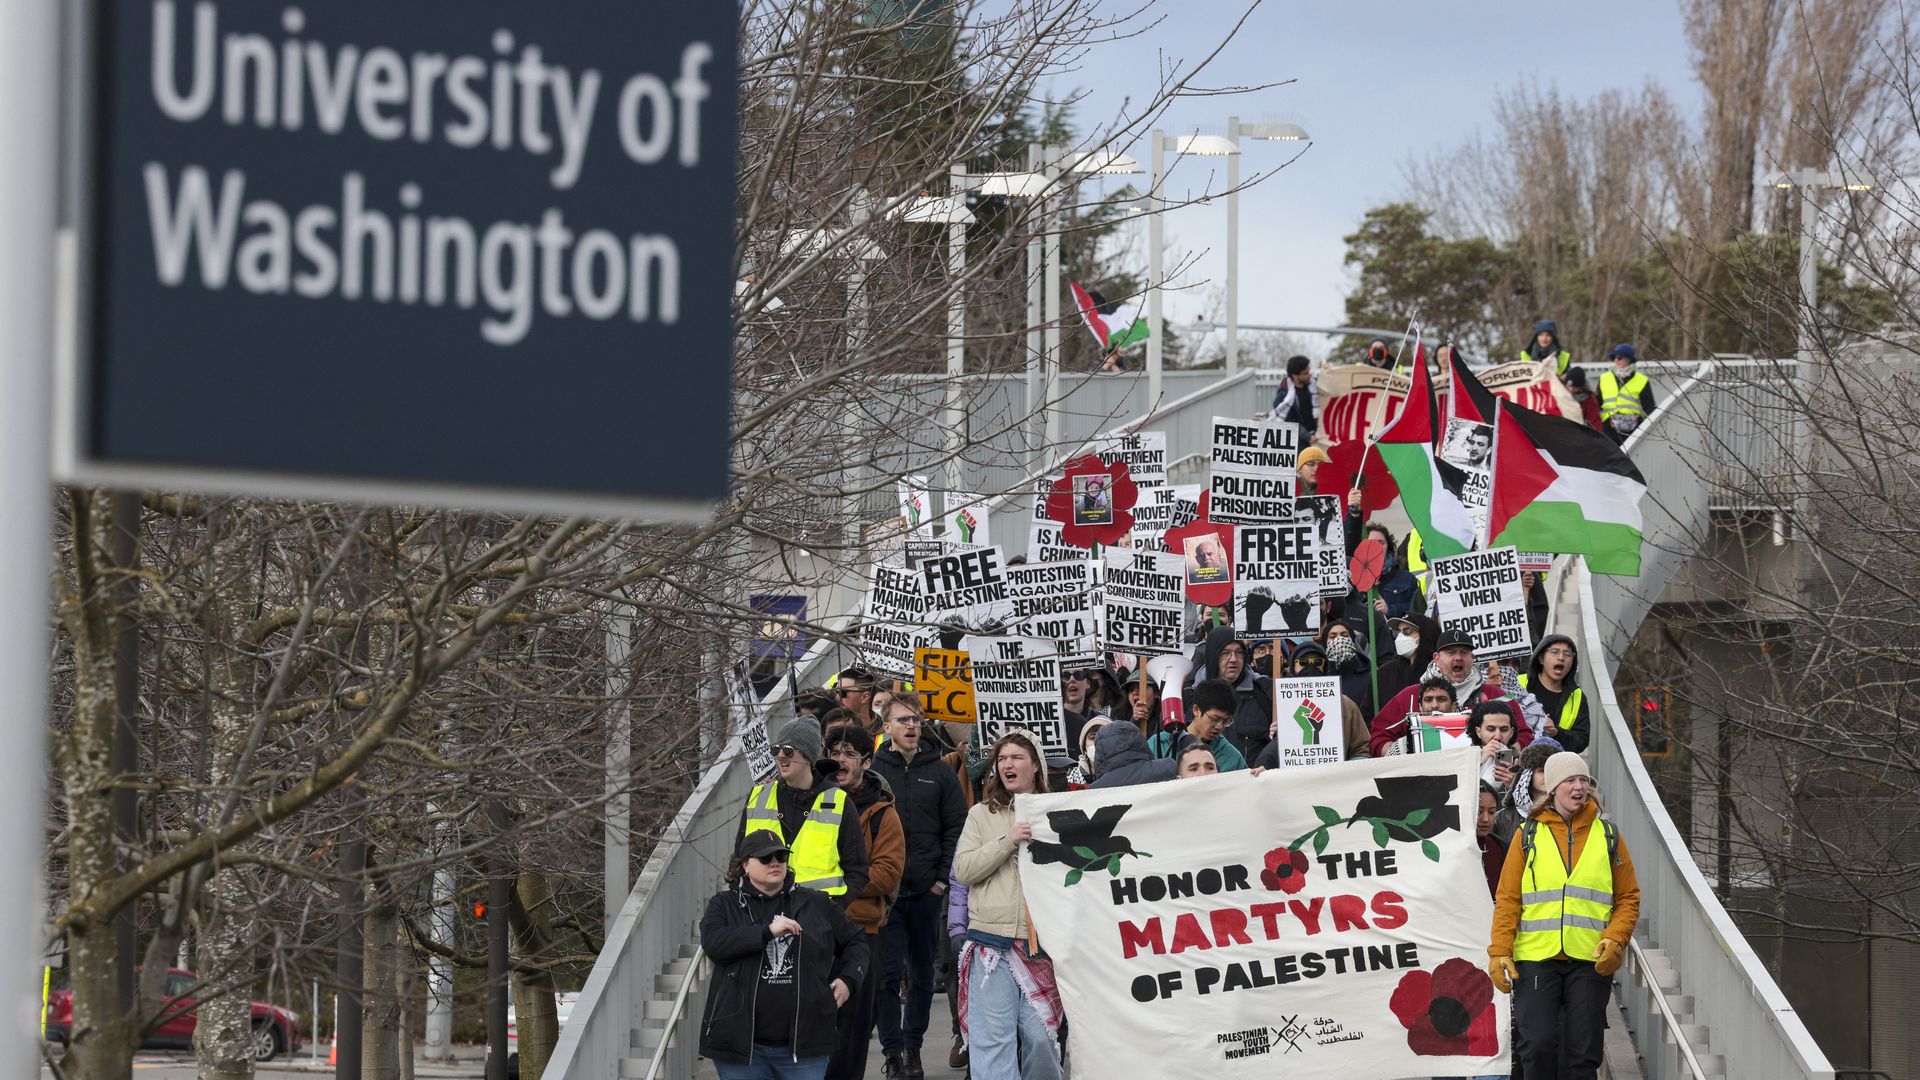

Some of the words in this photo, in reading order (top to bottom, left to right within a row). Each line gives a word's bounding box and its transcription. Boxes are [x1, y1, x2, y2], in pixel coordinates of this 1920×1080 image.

[150, 0, 603, 188] University
[616, 41, 714, 167] of
[143, 161, 681, 346] Washington
[1481, 367, 1534, 385] ORKERS
[1122, 437, 1141, 450] THE
[1213, 424, 1258, 448] FREE
[1262, 428, 1295, 450] ALL
[1099, 450, 1164, 465] MOVEMENT
[1212, 447, 1296, 468] PALESTINIAN
[1143, 465, 1164, 474] UNTIL
[1154, 490, 1175, 504] THE
[1212, 475, 1293, 499] POLITICAL
[1133, 505, 1173, 520] MOVE
[1211, 496, 1293, 517] PRISONERS
[1133, 521, 1168, 531] CONTINU
[1037, 529, 1051, 545] IS
[1240, 526, 1313, 562] FREE
[922, 548, 1001, 594] FREE
[1133, 554, 1157, 571] THE
[1236, 561, 1319, 581] PALESTINE
[1434, 550, 1516, 577] RESISTANCE
[875, 568, 922, 596] RELEA
[1006, 564, 1086, 585] PROTESTING
[1107, 568, 1183, 591] MOVEMENT
[1437, 578, 1452, 594] IS
[1454, 567, 1518, 591] JUSTIFIED
[924, 581, 1010, 612] PALESTINE
[1010, 581, 1087, 597] AGAINST
[1107, 585, 1155, 601] CONTINUES
[1157, 591, 1182, 603] UNTIL
[1459, 587, 1502, 608] WHEN
[873, 588, 923, 613] MAHMO
[1106, 604, 1182, 627] PALESTINE
[1443, 613, 1496, 632] PEOPLE
[1499, 608, 1525, 626] ARE
[864, 624, 910, 648] HANDS
[914, 636, 930, 648] OF
[1017, 623, 1033, 636] IS
[1037, 619, 1069, 639] NOT
[1074, 619, 1085, 636] A
[1106, 621, 1124, 642] IS
[1129, 623, 1180, 649] FREE!
[1472, 627, 1524, 650] CUPIED!
[884, 646, 914, 661] STUDE
[997, 641, 1025, 659] THE
[921, 654, 973, 683] FUC
[973, 660, 1056, 679] MOVEMENT
[976, 681, 1027, 693] CONTINUES
[1029, 680, 1058, 692] UNTIL
[1281, 690, 1292, 699] TO
[1295, 690, 1313, 699] THE
[1316, 689, 1335, 698] SEA
[919, 689, 971, 717] I.C.
[979, 701, 1060, 721] PALESTINE
[980, 721, 1001, 746] IS
[1284, 747, 1338, 757] PALESTINE
[1109, 863, 1251, 905] HONOR
[1317, 849, 1398, 880] THE
[1118, 890, 1410, 959] MARTYRS
[1130, 970, 1183, 1002] OF
[1194, 942, 1421, 995] PALESTINE
[1217, 1027, 1268, 1043] PALESTINIAN
[1243, 1036, 1269, 1049] YOUTH
[1225, 1045, 1271, 1060] MOVEMENT
